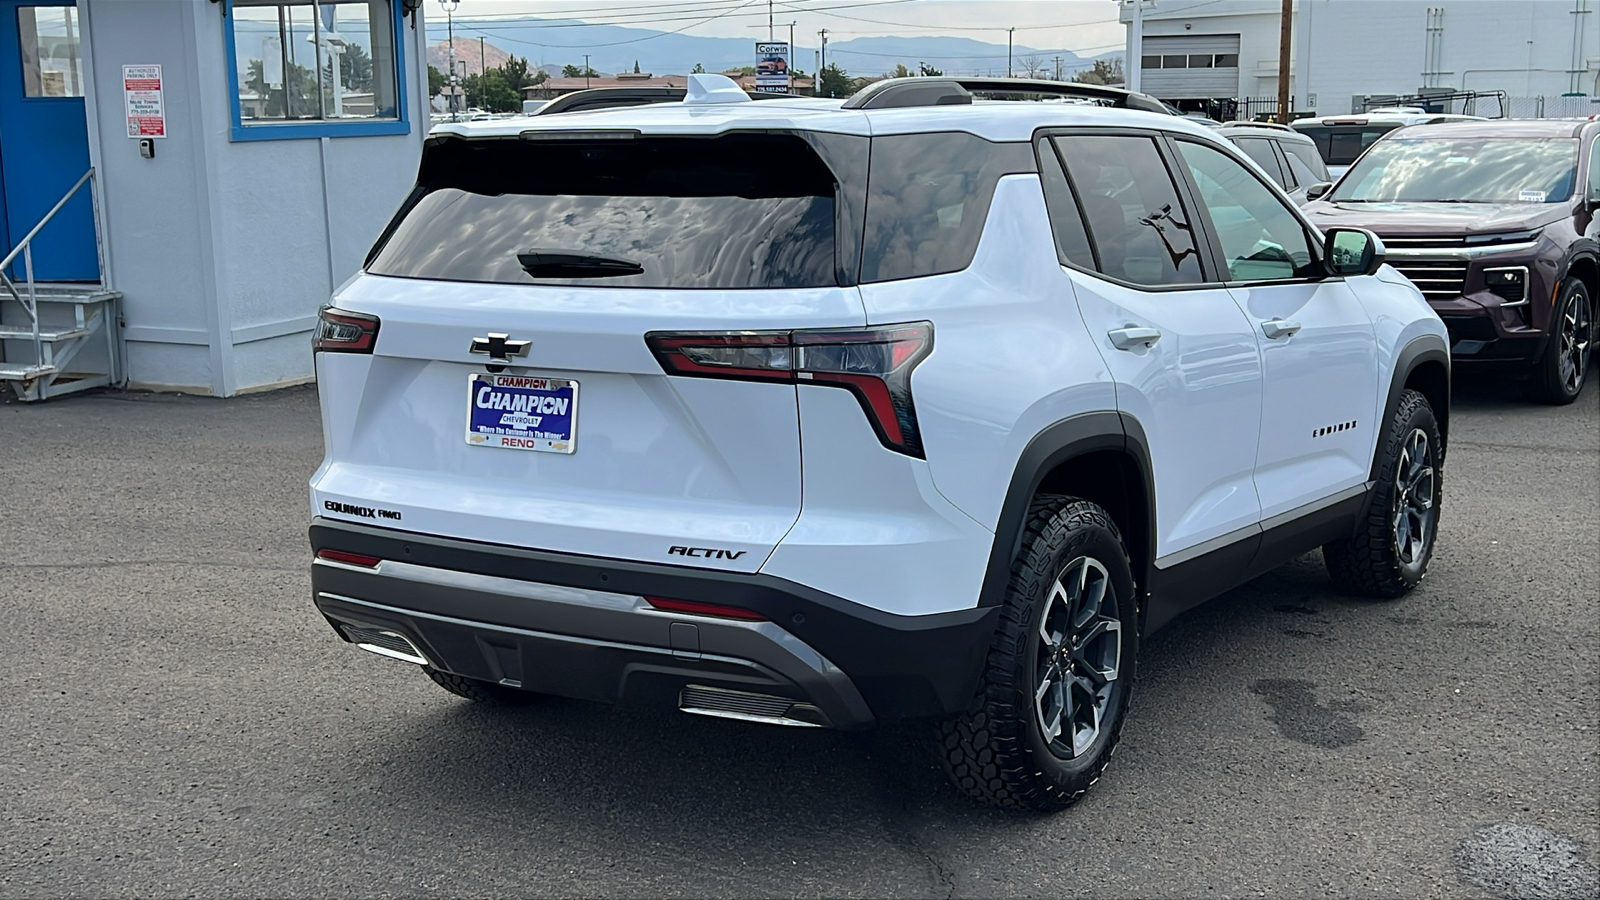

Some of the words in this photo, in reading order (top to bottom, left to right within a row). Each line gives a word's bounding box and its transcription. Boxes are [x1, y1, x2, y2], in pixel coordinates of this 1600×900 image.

[759, 45, 787, 53] Corwin
[497, 376, 547, 389] CHAMPION
[476, 386, 569, 415] CHAMPION
[502, 416, 539, 425] CHEVROLET
[496, 426, 505, 435] The
[506, 428, 529, 437] Customer
[534, 430, 544, 439] The
[501, 437, 535, 448] RENO
[324, 500, 376, 519] EQUINOX
[667, 545, 748, 560] ACTIV
